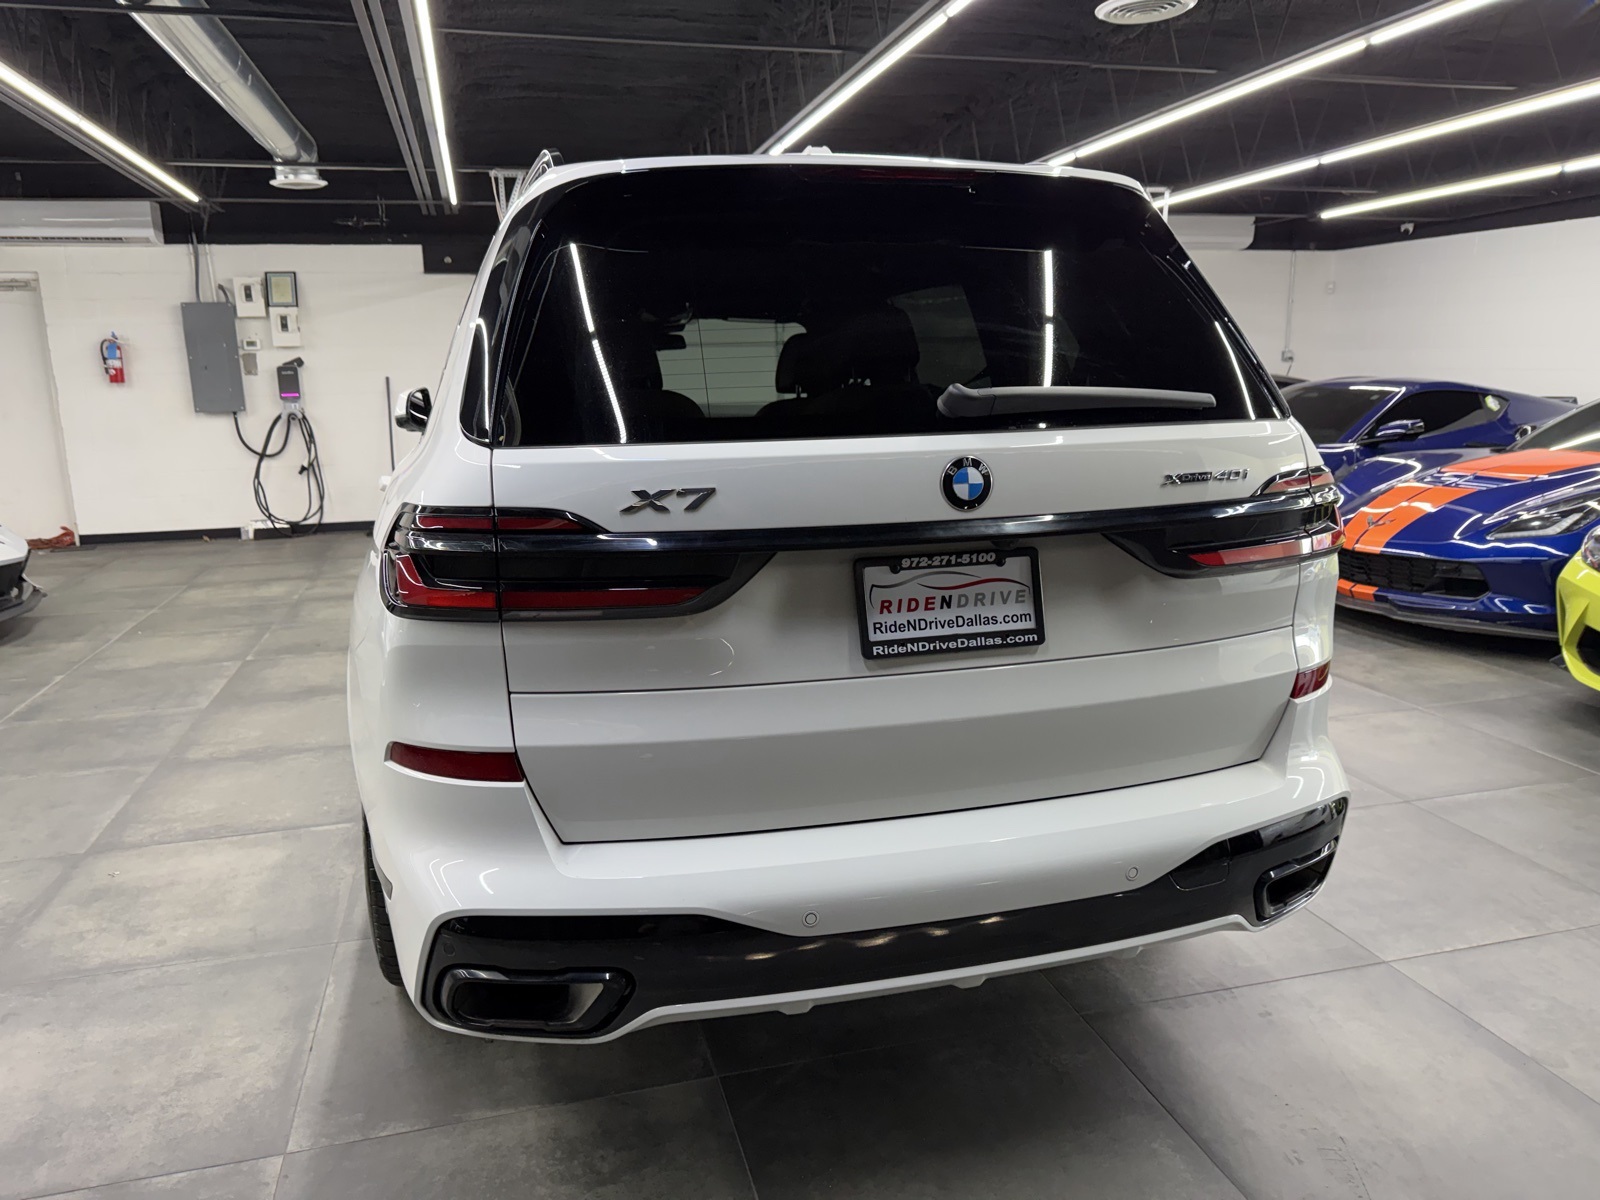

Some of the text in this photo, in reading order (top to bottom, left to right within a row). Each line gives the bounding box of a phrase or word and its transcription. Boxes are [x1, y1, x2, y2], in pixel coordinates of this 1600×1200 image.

[946, 457, 989, 475] BMW
[620, 487, 716, 511] X7
[901, 552, 996, 568] 972-271-5100
[872, 612, 1032, 635] RideNDriveDallas.com
[872, 633, 1038, 656] RideNDriveDallas.com
